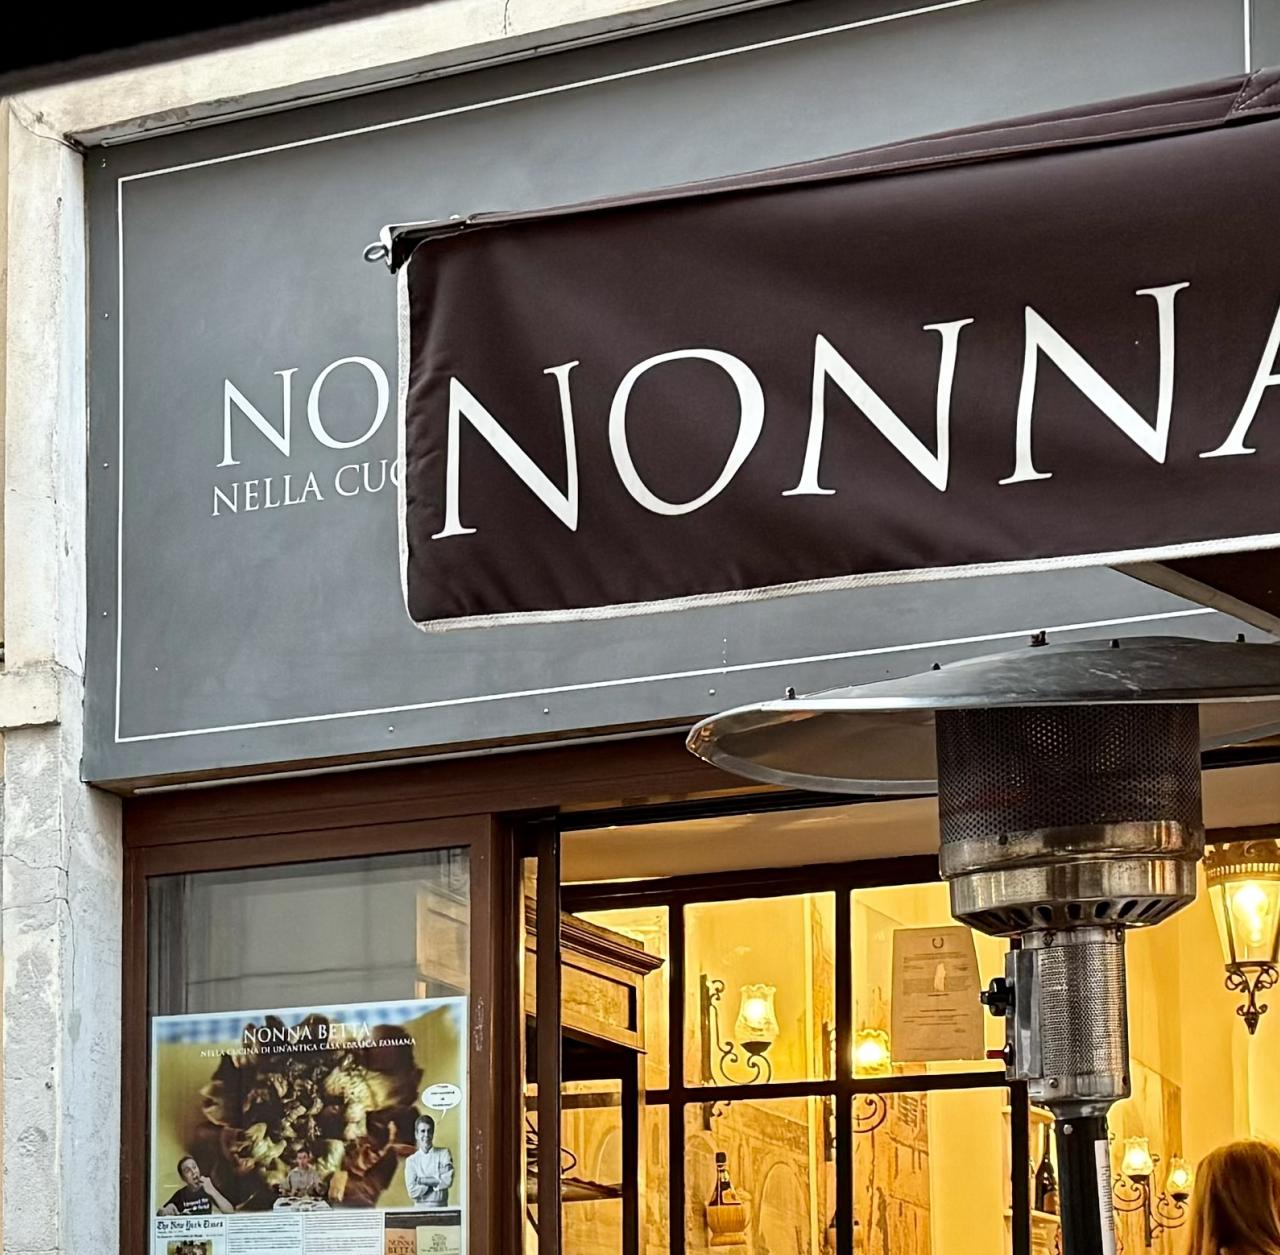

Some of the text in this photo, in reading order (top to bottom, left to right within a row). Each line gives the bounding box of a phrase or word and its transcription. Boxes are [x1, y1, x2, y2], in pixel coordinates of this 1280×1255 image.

[216, 355, 390, 468] NO
[211, 471, 325, 517] NELLA
[243, 1020, 370, 1044] NONNA BETTA
[261, 1045, 270, 1054] DI
[272, 1042, 318, 1054] UN'ANTICA
